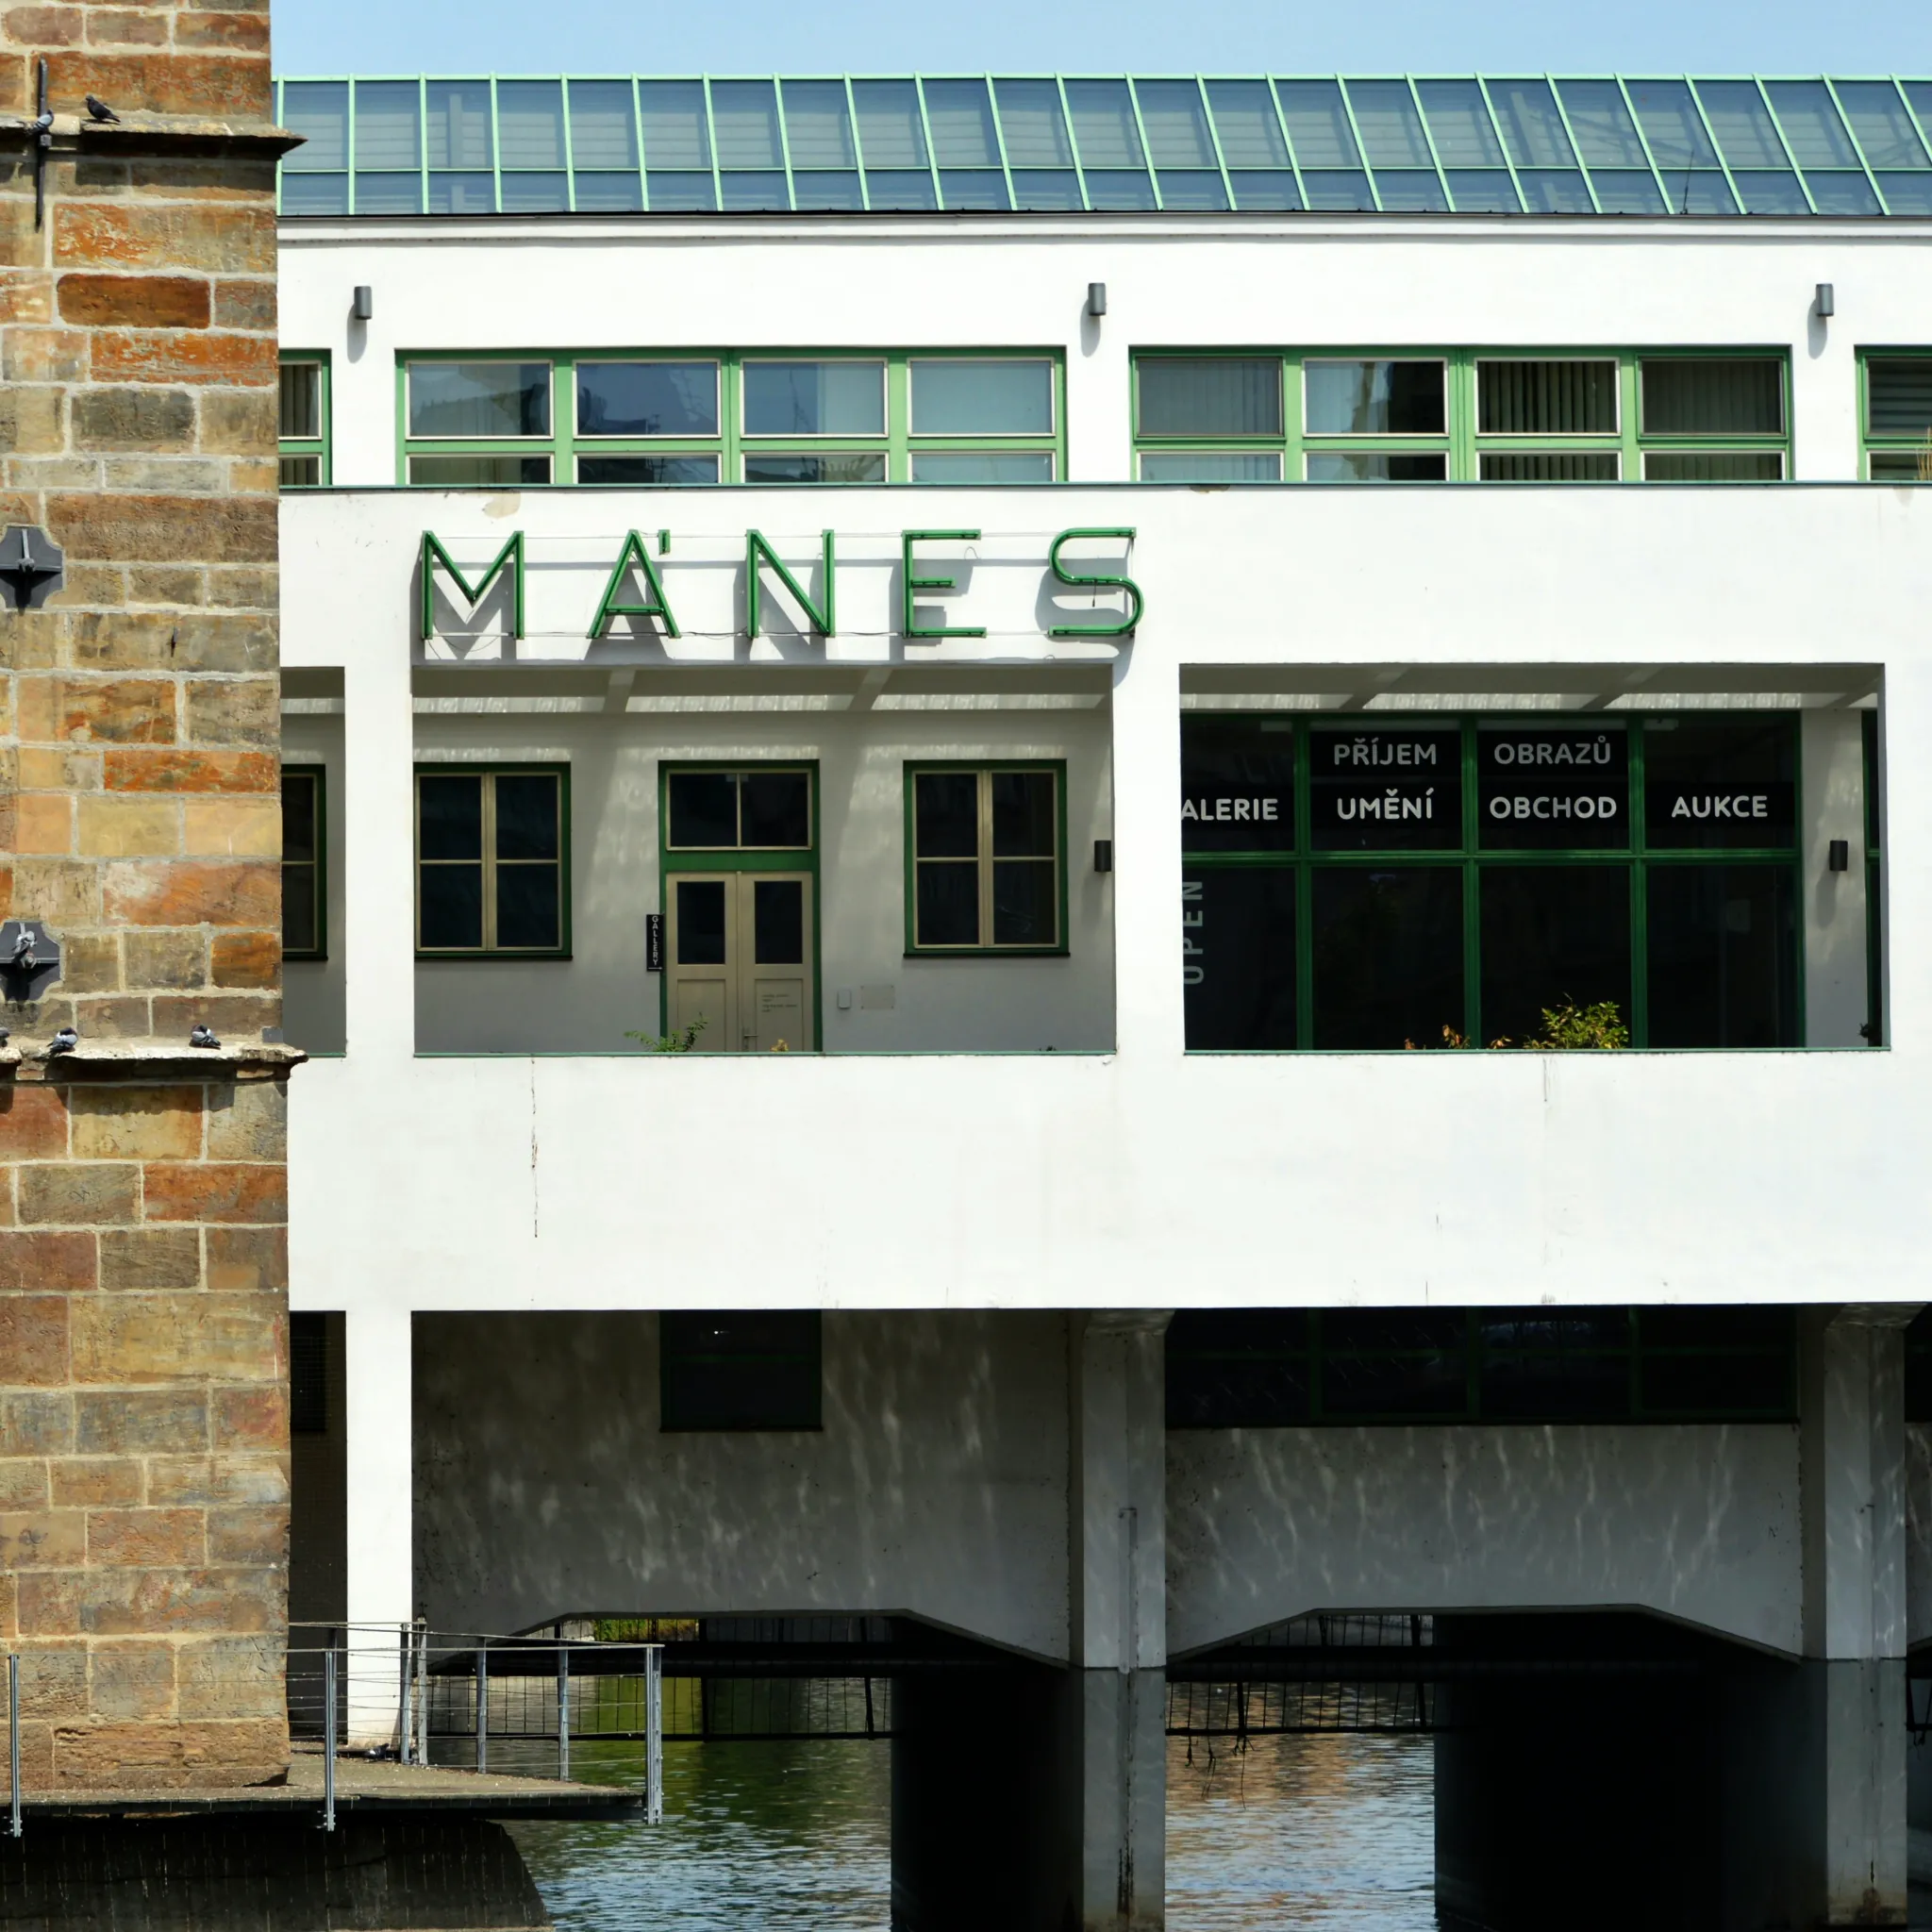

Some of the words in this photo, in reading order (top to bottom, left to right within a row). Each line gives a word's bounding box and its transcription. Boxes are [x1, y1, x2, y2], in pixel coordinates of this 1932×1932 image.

[421, 528, 1144, 640] MÁNES
[1334, 737, 1436, 765] PŘÍJEM
[1494, 735, 1610, 764] OBRAZŮ
[1337, 787, 1434, 820] UMĚNÍ
[1490, 796, 1617, 819] OBCHOD
[1672, 795, 1768, 818] AUKCE
[651, 915, 659, 966] GALLERY
